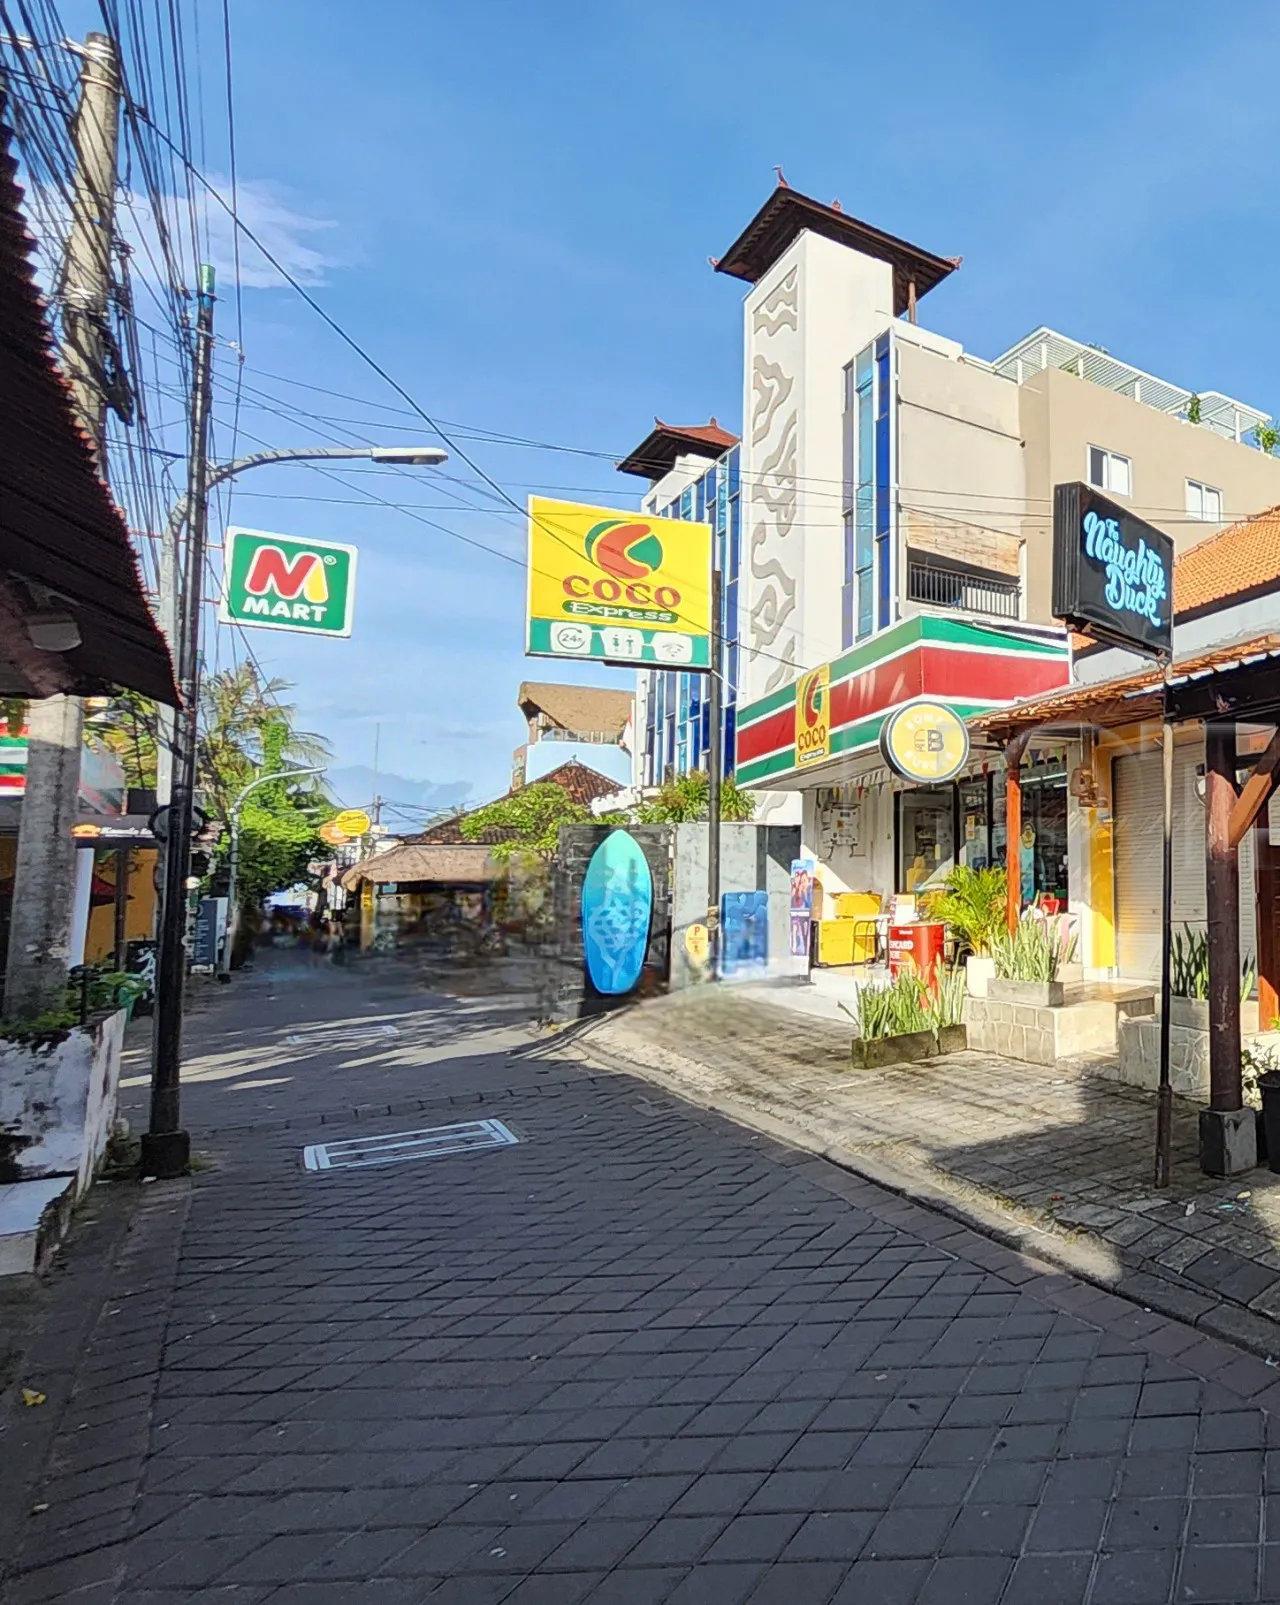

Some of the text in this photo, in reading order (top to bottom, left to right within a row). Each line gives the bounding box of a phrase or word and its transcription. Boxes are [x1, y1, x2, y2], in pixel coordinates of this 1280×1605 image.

[1083, 511, 1166, 600] Naughty
[563, 575, 681, 607] COCO
[1105, 564, 1161, 627] Duck
[242, 597, 327, 621] MART
[570, 601, 672, 621] Express
[798, 725, 826, 751] COCO
